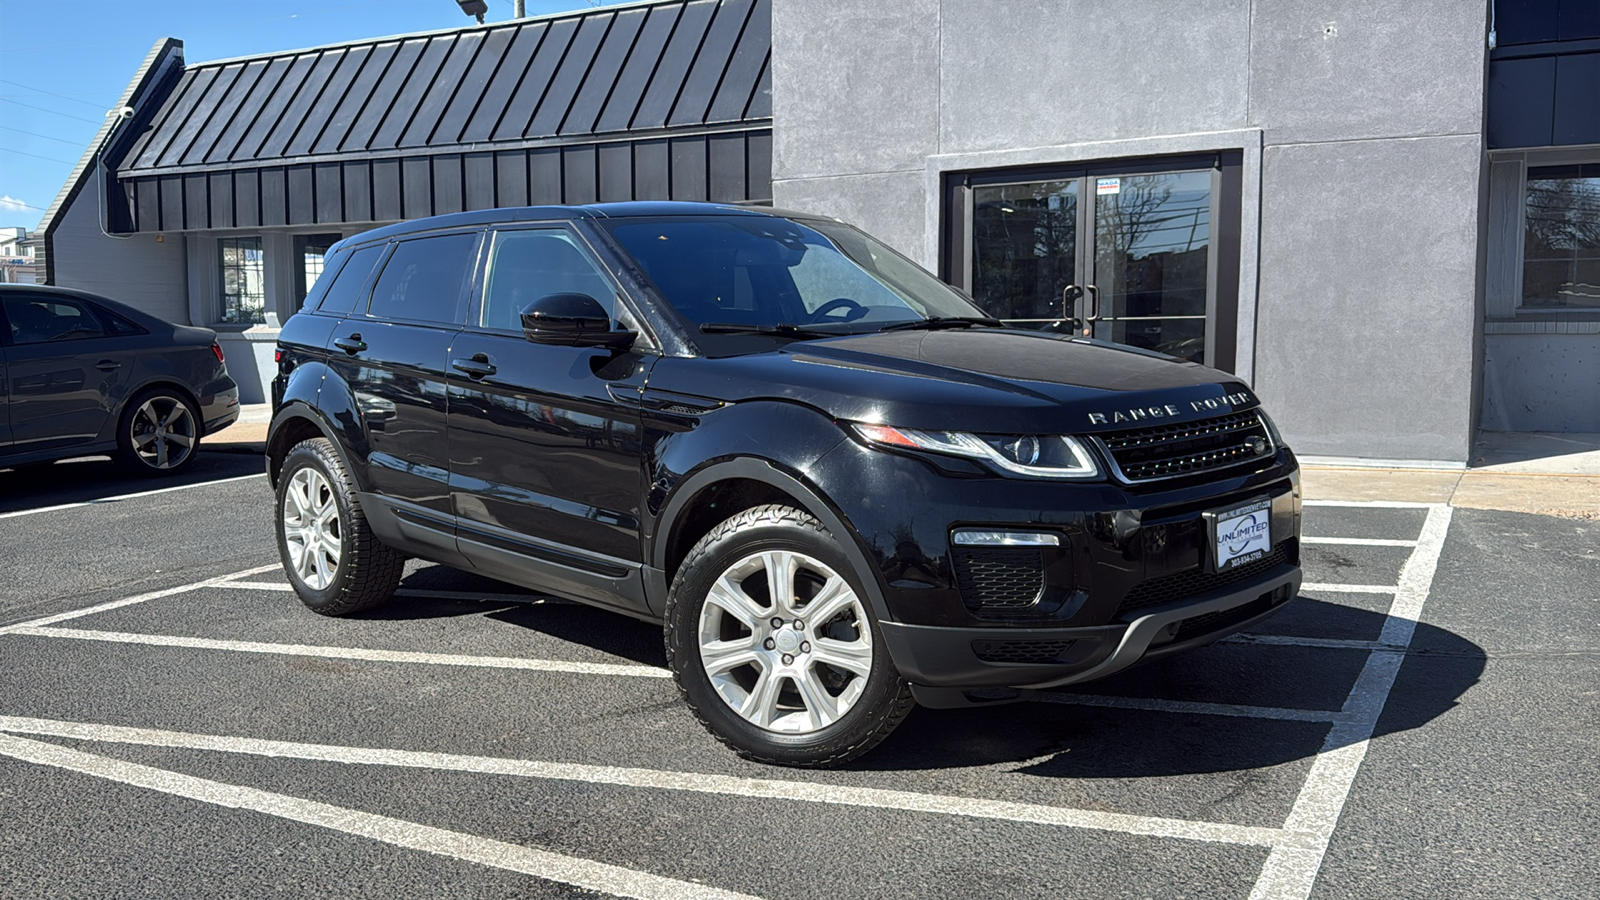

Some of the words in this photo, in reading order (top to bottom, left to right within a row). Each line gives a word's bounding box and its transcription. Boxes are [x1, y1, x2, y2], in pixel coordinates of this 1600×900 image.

[1088, 404, 1181, 425] RANGE
[1190, 391, 1251, 412] ROVER
[1217, 521, 1268, 544] UNLIMITED
